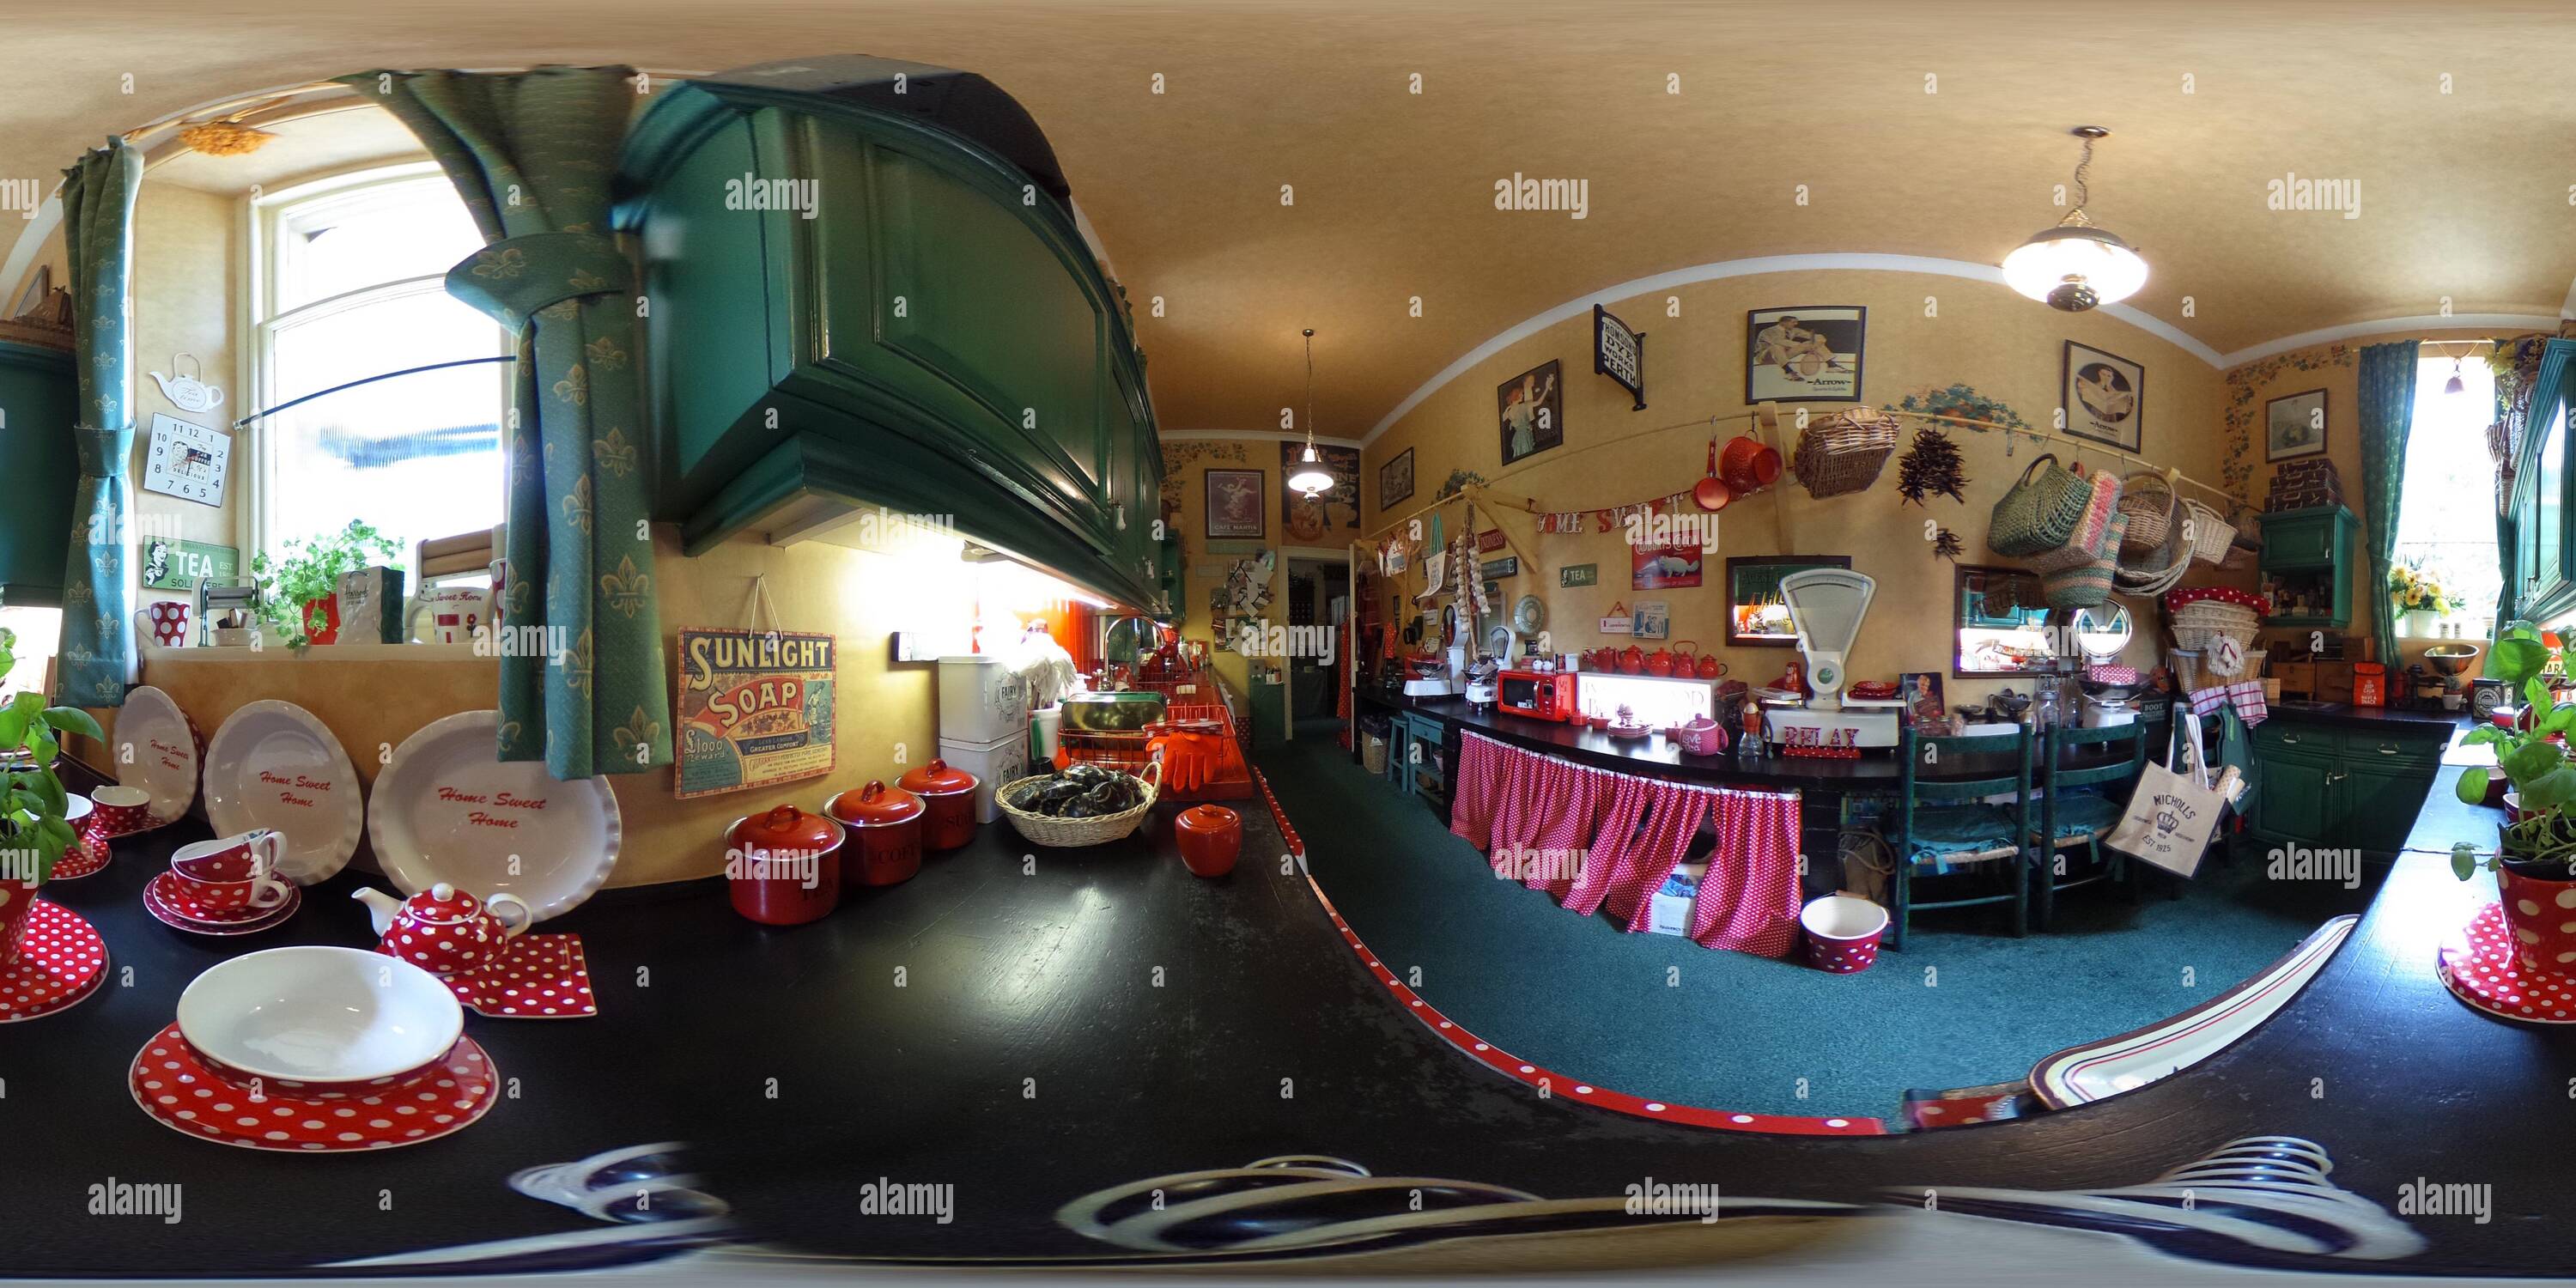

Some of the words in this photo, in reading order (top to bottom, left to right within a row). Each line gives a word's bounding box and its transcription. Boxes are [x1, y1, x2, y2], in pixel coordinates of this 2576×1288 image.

[1607, 336, 1633, 361] DYE
[1605, 344, 1634, 372] WORKS
[1602, 353, 1636, 386] PERTH
[173, 423, 184, 434] 11
[189, 428, 199, 438] 12
[157, 433, 167, 442] 10
[157, 447, 163, 456] 9
[155, 464, 161, 473] 8
[167, 480, 174, 489] 7
[184, 484, 190, 494] 6
[213, 480, 220, 489] 4
[199, 489, 206, 498] 5
[1537, 513, 1583, 533] HOME
[175, 550, 214, 577] TEA
[1570, 569, 1586, 581] TEA
[688, 636, 829, 692] SUNLIGHT
[1001, 684, 1017, 698] FAIRY
[707, 682, 798, 728] SOAP
[2144, 702, 2164, 712] BOOT
[684, 729, 723, 754] £1000
[1783, 726, 1860, 748] RELAX
[150, 738, 169, 752] Home
[170, 745, 189, 760] Sweet
[749, 744, 776, 753] GREATER
[776, 741, 799, 750] COMFORT
[161, 756, 180, 770] Home
[1003, 764, 1019, 781] FAIRY
[259, 771, 291, 785] Home
[295, 775, 331, 792] Sweet
[280, 792, 314, 808] Home
[438, 787, 488, 804] Home
[493, 793, 547, 810] Sweet
[2153, 794, 2196, 819] NICHOLLS
[468, 811, 519, 829] Home
[2142, 834, 2156, 848] EST
[2156, 844, 2172, 853] 1925
